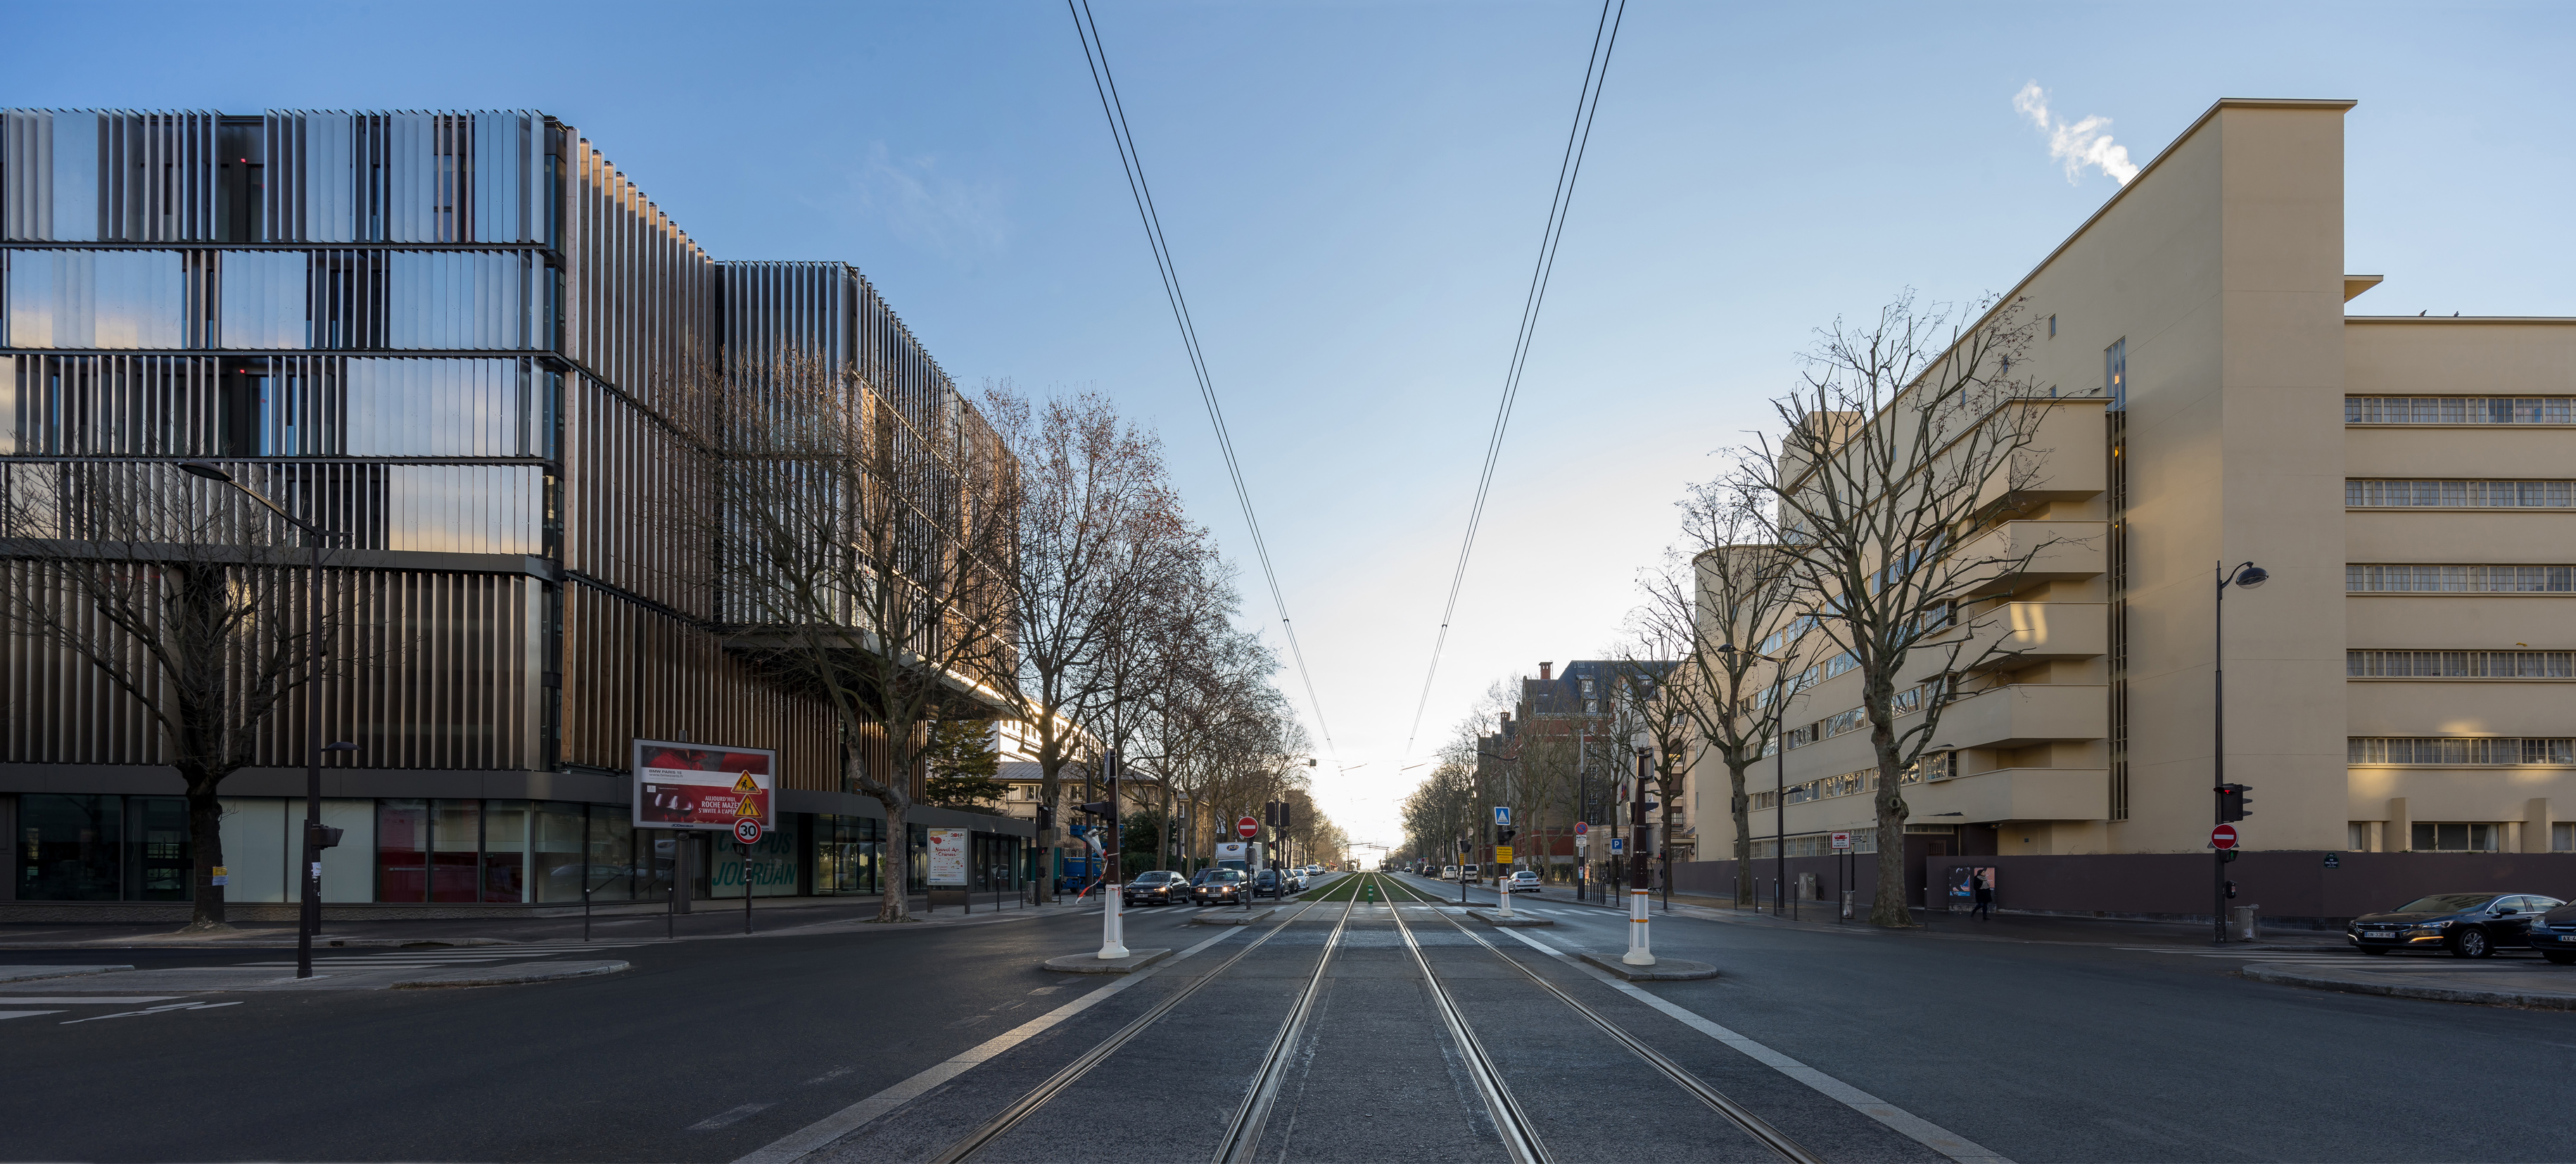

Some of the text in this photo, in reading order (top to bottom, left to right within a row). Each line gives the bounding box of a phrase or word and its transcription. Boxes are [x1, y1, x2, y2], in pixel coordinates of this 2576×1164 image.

[718, 831, 793, 854] CPUS
[740, 825, 756, 837] 30
[712, 862, 797, 886] JOURDAN
